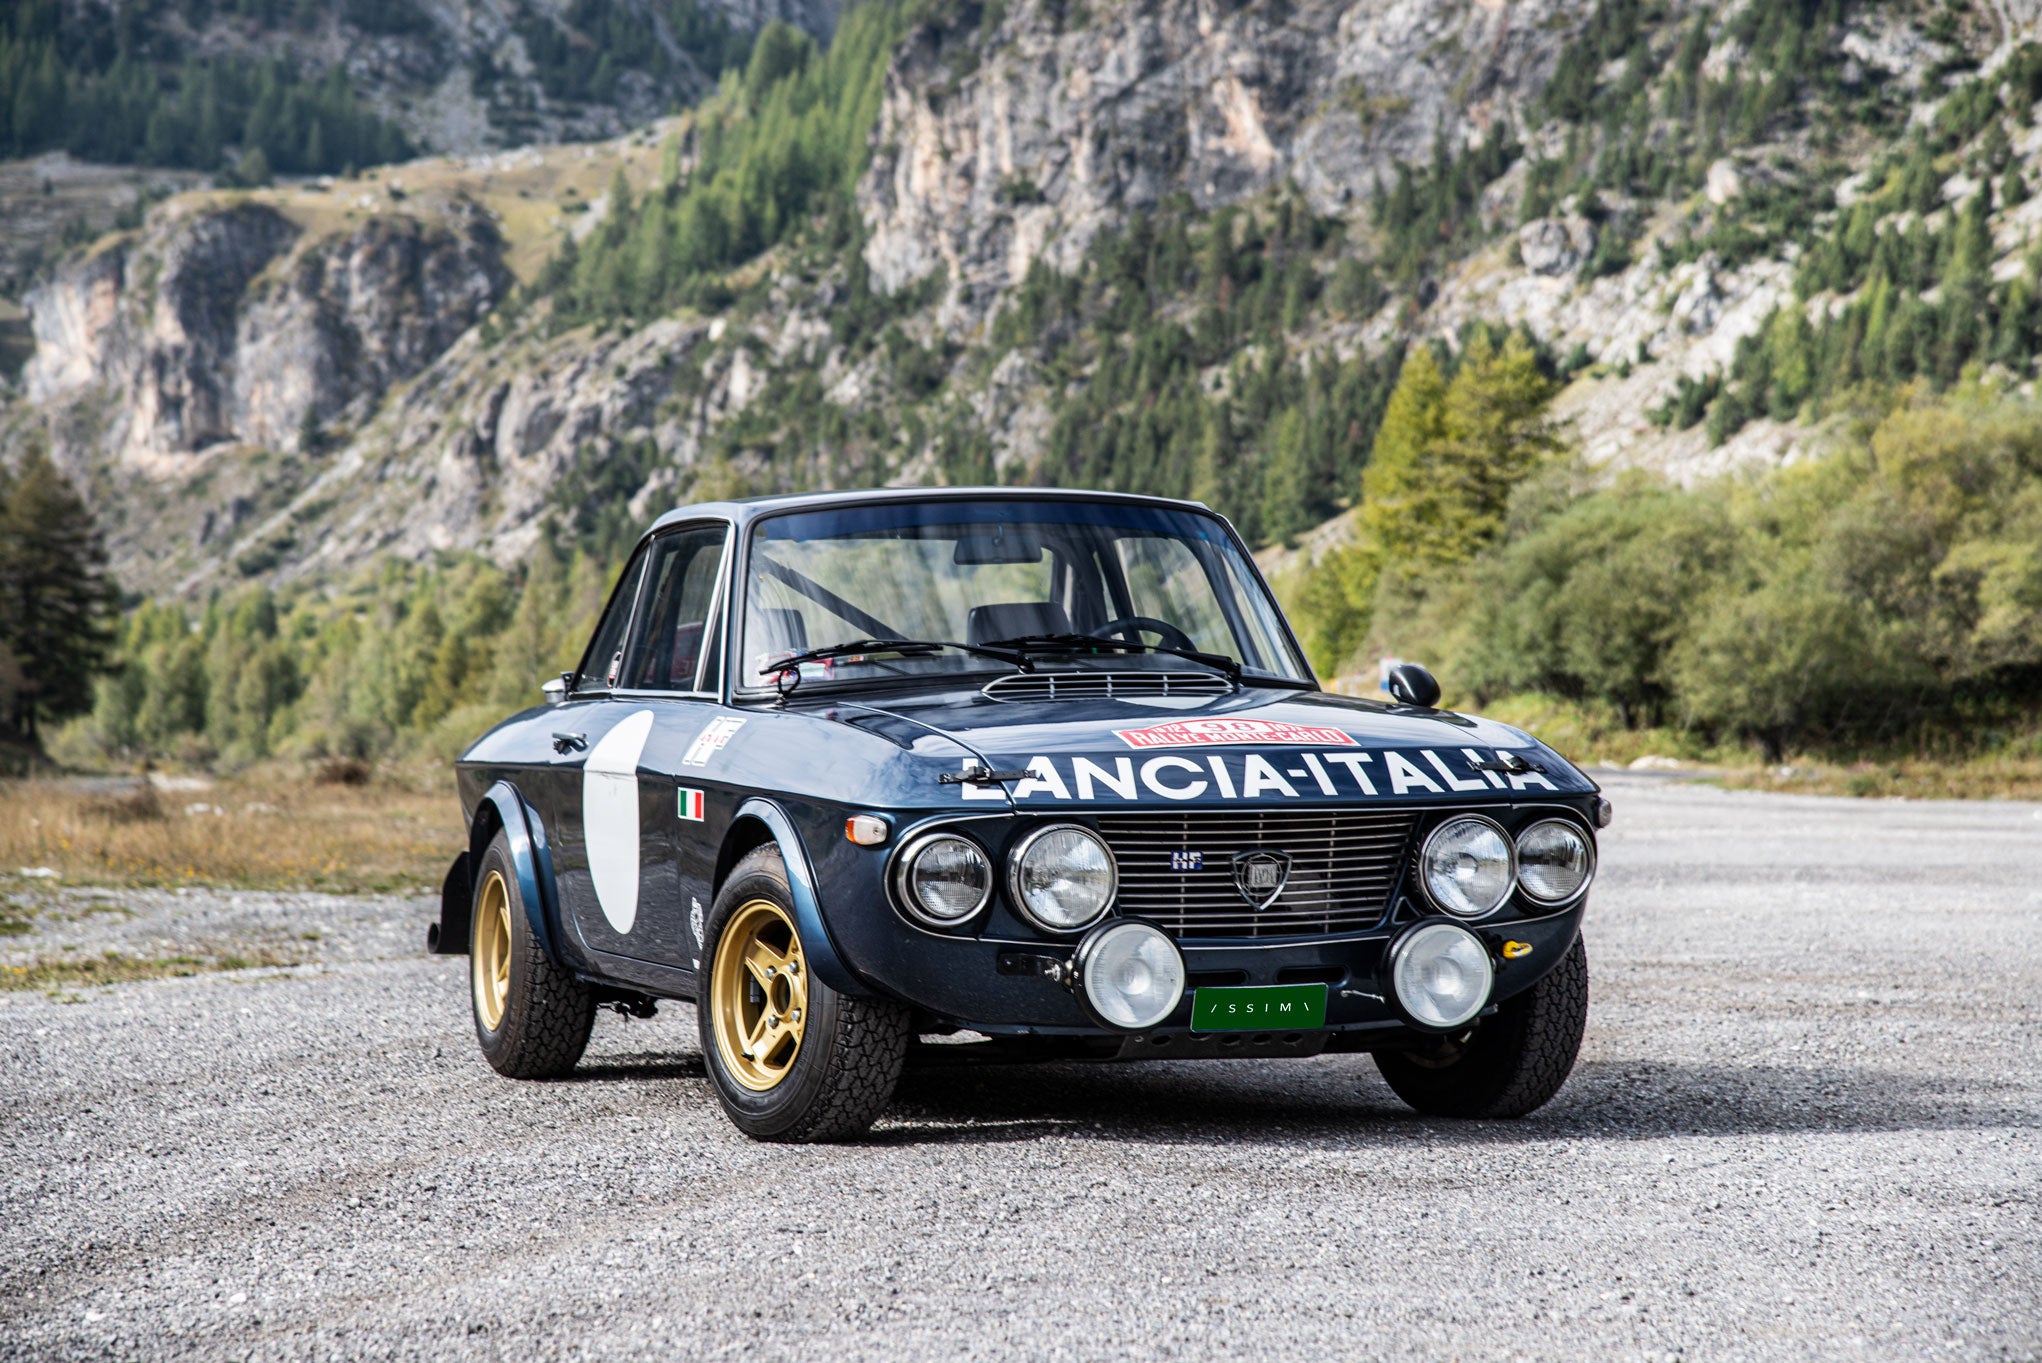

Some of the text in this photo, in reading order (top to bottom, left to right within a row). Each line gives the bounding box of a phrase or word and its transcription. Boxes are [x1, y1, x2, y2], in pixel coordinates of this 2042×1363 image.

[1201, 722, 1256, 732] 98
[1129, 731, 1207, 745] RALLYE
[1172, 851, 1202, 869] HF
